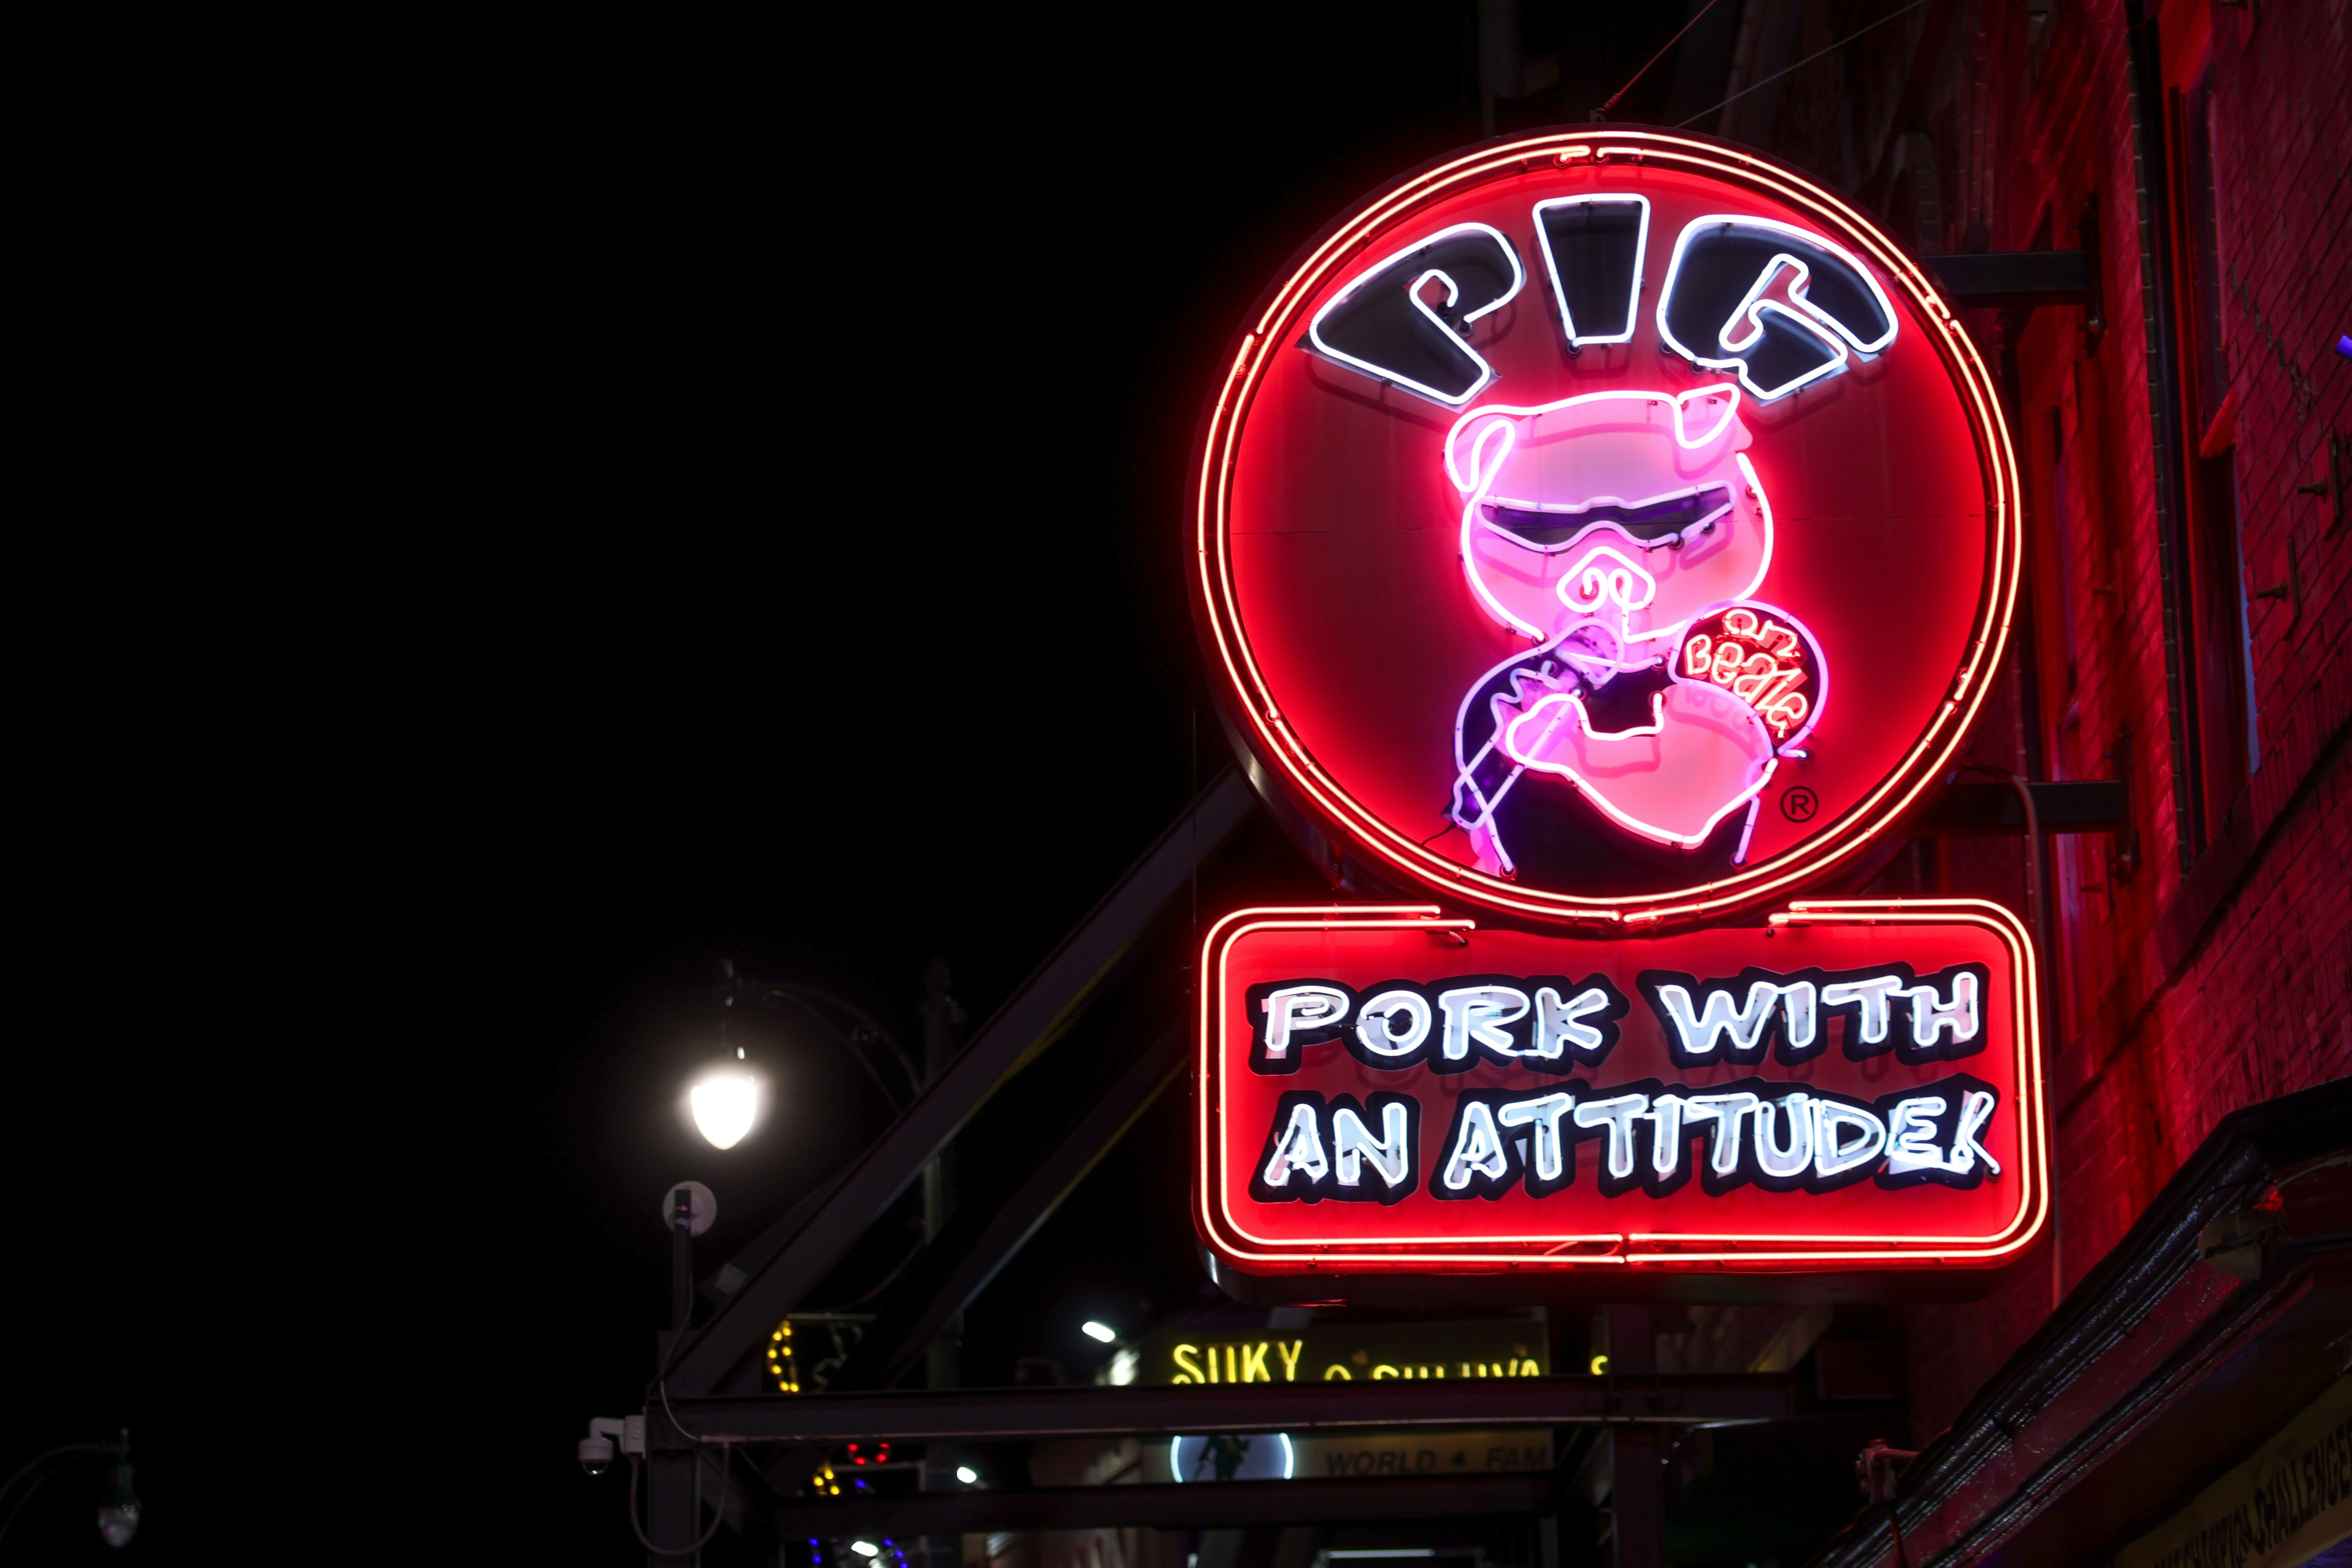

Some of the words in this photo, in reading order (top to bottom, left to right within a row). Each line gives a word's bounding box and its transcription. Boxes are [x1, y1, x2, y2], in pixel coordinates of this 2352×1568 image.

[1303, 193, 1899, 408] PIG
[1722, 608, 1801, 659] on
[1684, 633, 1809, 735] Beale
[1260, 983, 1610, 1062] PORK
[1653, 971, 1980, 1054] WITH
[1262, 1102, 1410, 1189] AN
[1443, 1091, 2001, 1190] ATTITUDE!
[1325, 1449, 1438, 1477] WORLD
